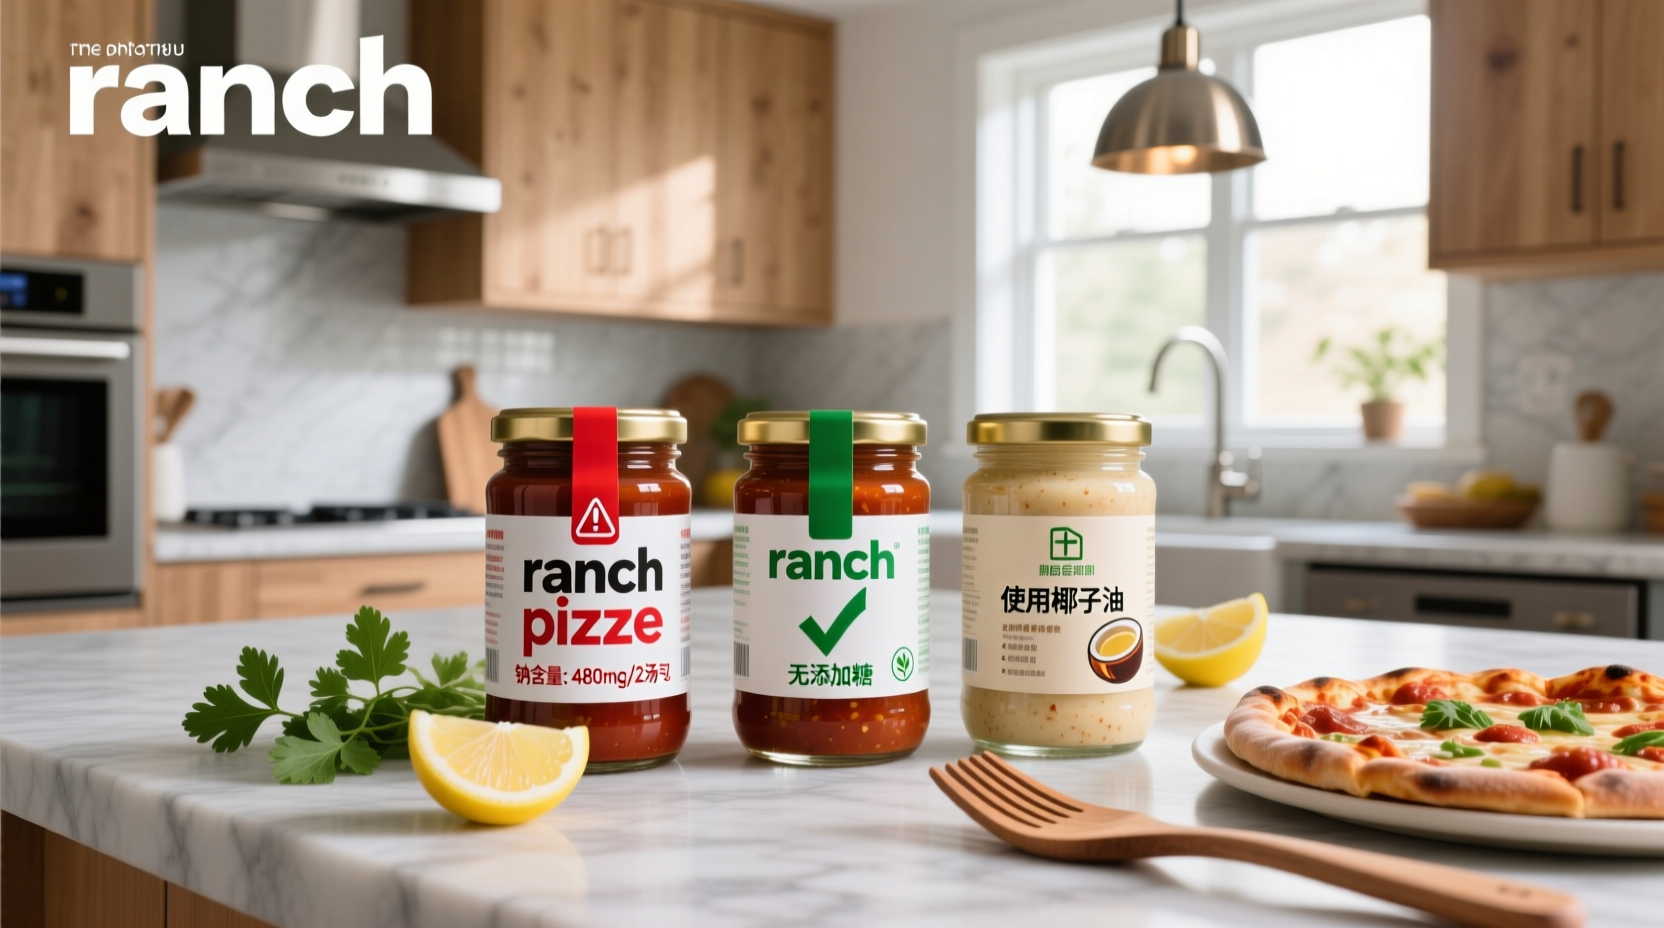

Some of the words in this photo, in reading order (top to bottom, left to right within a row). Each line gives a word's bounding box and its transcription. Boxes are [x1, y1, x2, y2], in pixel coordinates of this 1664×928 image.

[523, 546, 663, 594] ranch
[768, 539, 895, 580] ranch
[1000, 585, 1124, 615] 使用椰子油
[523, 595, 663, 657] pizze
[788, 662, 874, 687] 无添加糖
